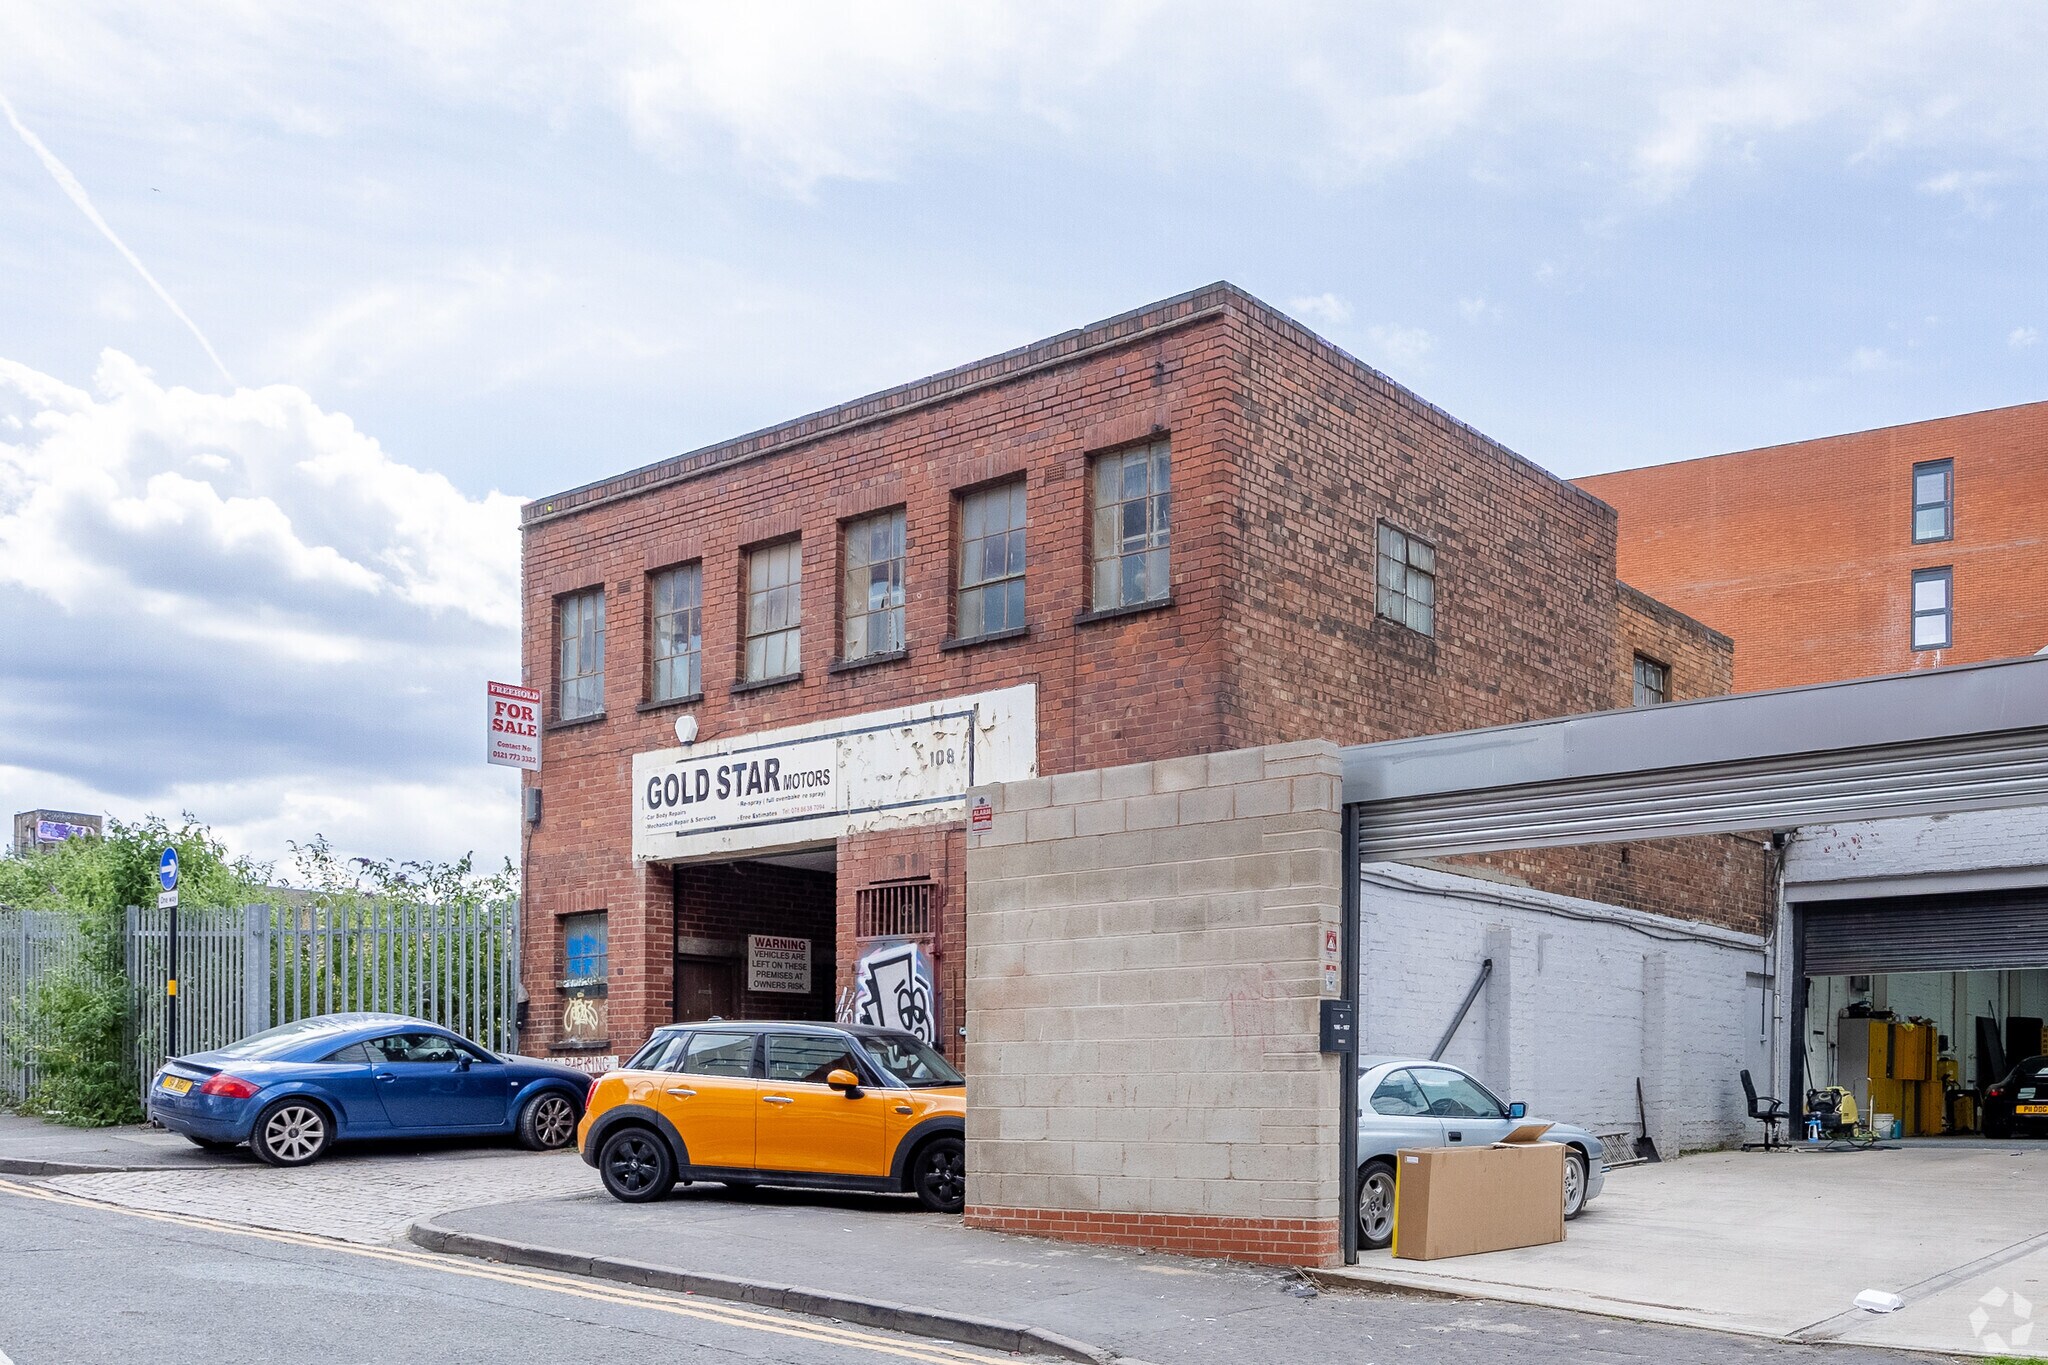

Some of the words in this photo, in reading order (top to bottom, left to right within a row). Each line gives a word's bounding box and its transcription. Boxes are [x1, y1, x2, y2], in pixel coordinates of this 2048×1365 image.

[490, 684, 539, 700] FREEHOLD
[495, 702, 534, 721] FOR
[493, 719, 536, 737] SALE
[497, 741, 521, 750] Contact
[492, 750, 508, 759] 0121
[509, 753, 521, 761] 773
[521, 755, 537, 763] 3322
[930, 748, 954, 767] 108
[647, 768, 710, 810] GOLD
[716, 757, 780, 800] STAR
[783, 769, 830, 791] MOTORS
[752, 811, 777, 819] Estimates
[754, 937, 806, 950] WARNING
[754, 950, 790, 960] VEHICLES
[791, 953, 806, 961] ARE
[752, 960, 770, 968] LEFT
[772, 961, 783, 969] ON
[784, 962, 807, 971] THESE
[756, 970, 793, 979] PREMISES
[753, 980, 786, 989] OWNERS
